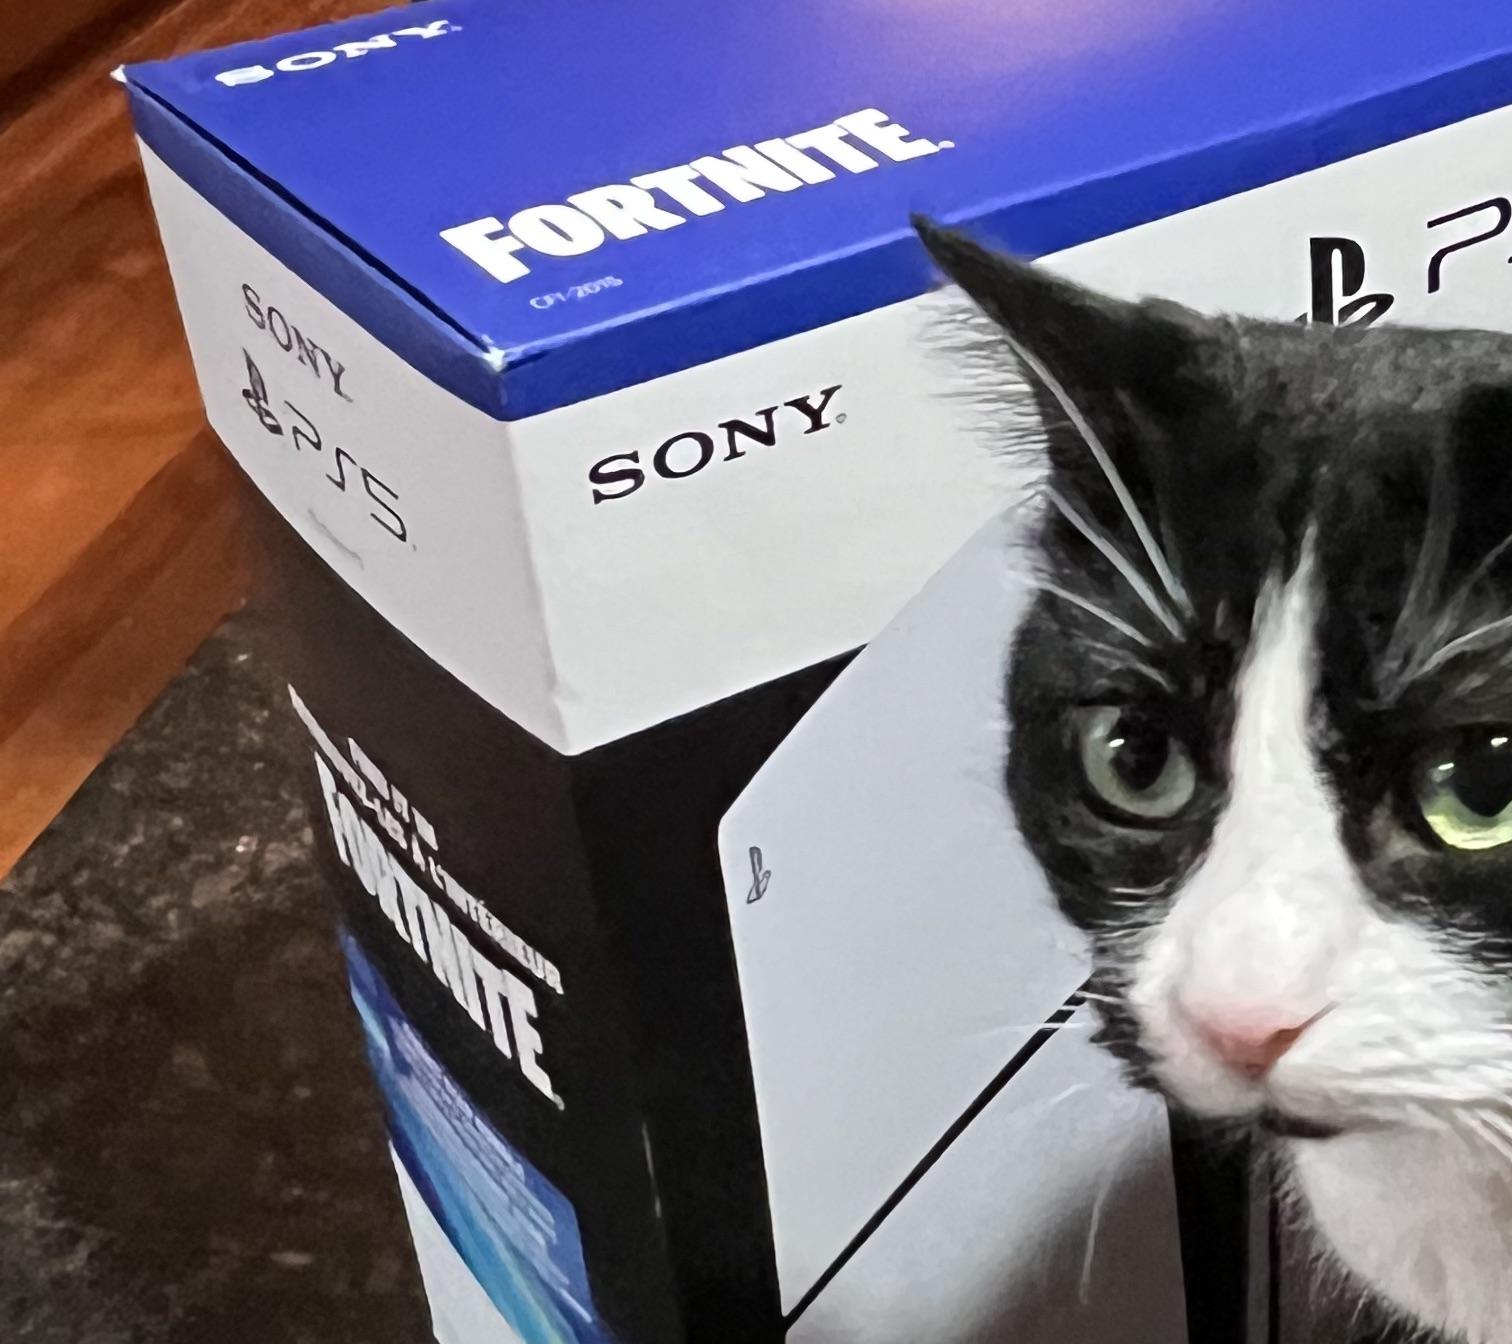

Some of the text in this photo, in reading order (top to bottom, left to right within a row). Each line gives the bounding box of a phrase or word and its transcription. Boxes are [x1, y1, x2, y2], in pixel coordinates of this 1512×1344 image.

[214, 20, 450, 87] SONY
[439, 108, 944, 284] FORTNITE
[242, 277, 353, 403] SONY
[284, 399, 408, 543] PS5
[587, 386, 843, 506] SONY
